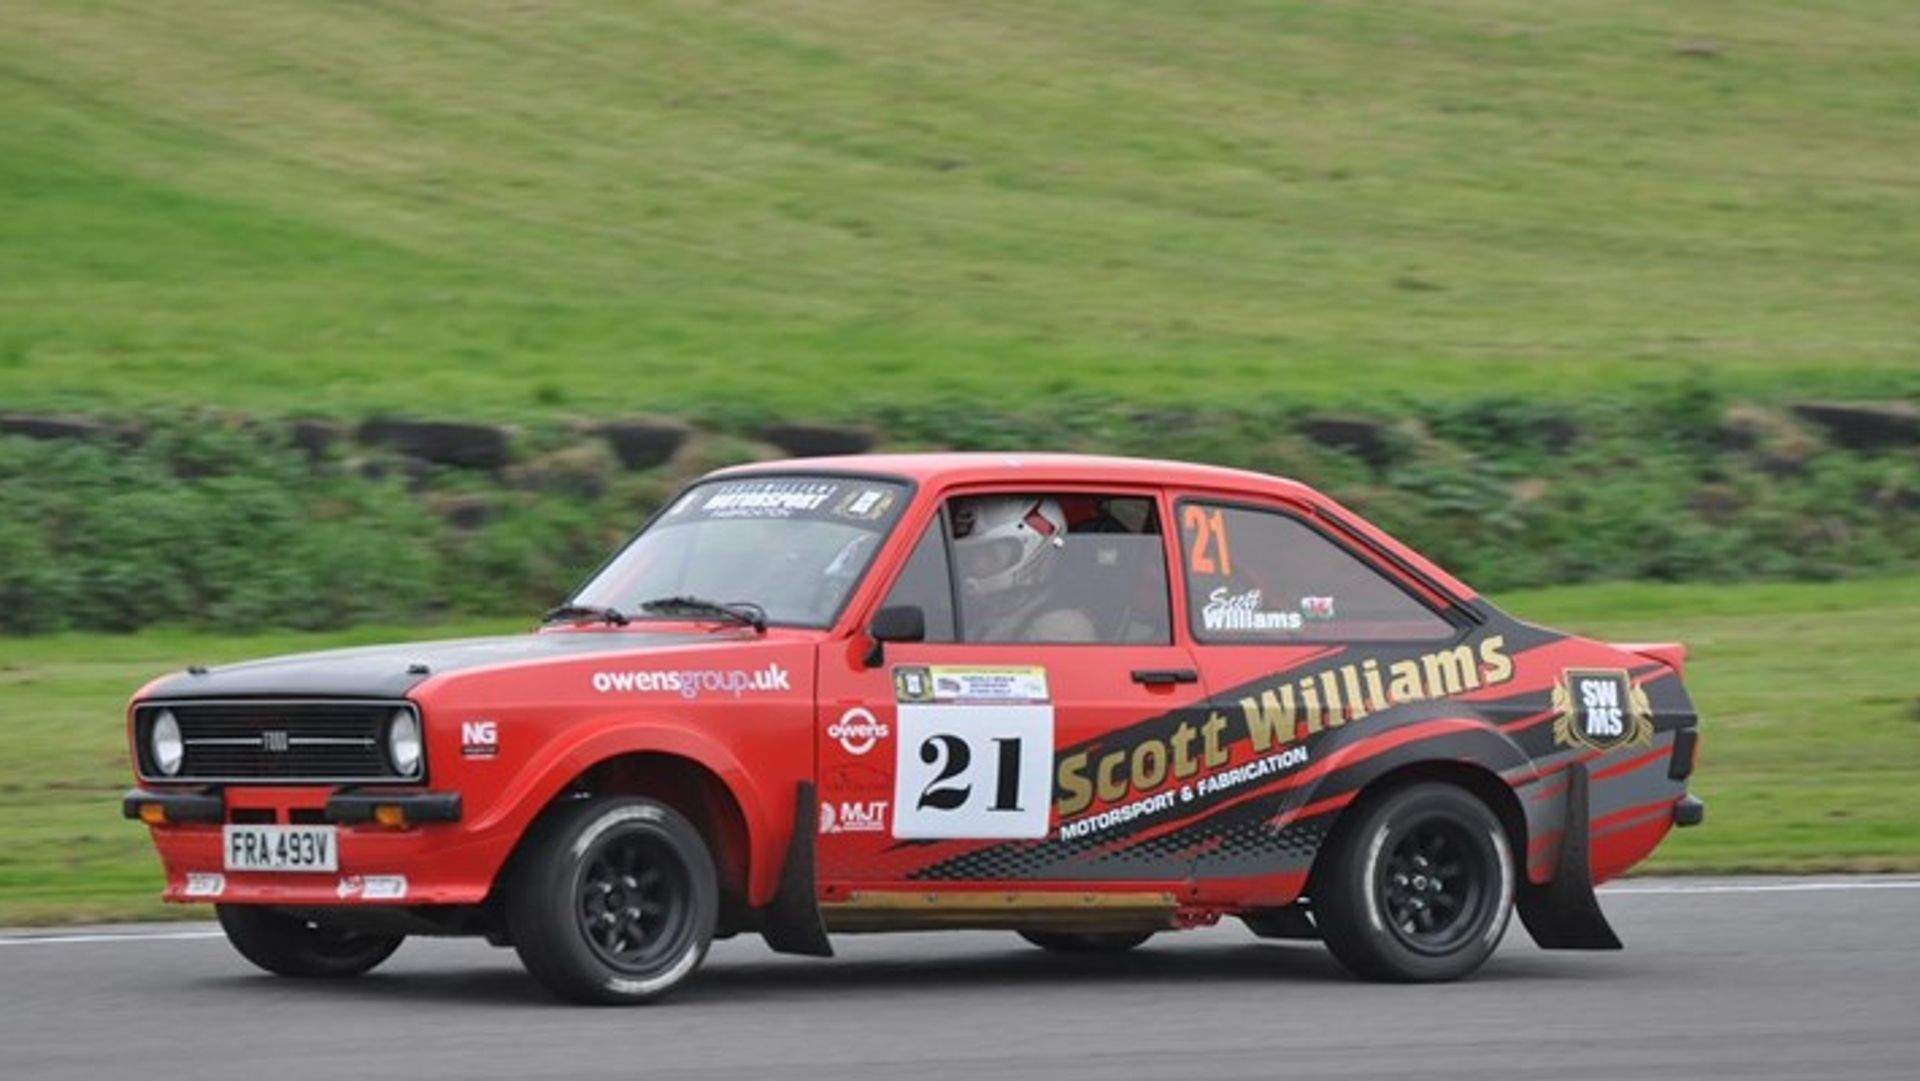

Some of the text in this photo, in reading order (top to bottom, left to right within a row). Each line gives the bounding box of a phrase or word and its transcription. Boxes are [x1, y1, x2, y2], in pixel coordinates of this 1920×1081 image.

[1183, 504, 1232, 576] 21
[1208, 586, 1261, 609] Scott
[1202, 604, 1302, 630] Williams
[592, 662, 790, 699] owensgroup.uk
[1580, 679, 1618, 707] SW
[461, 720, 497, 744] NG
[827, 722, 889, 739] owens
[1057, 634, 1513, 817] Scott Williams
[1586, 706, 1623, 737] MS
[916, 734, 1025, 812] 21
[1060, 746, 1309, 841] MOTORSPORT & FABRICATION
[840, 802, 889, 820] MJT
[230, 832, 328, 865] FRA 493V
